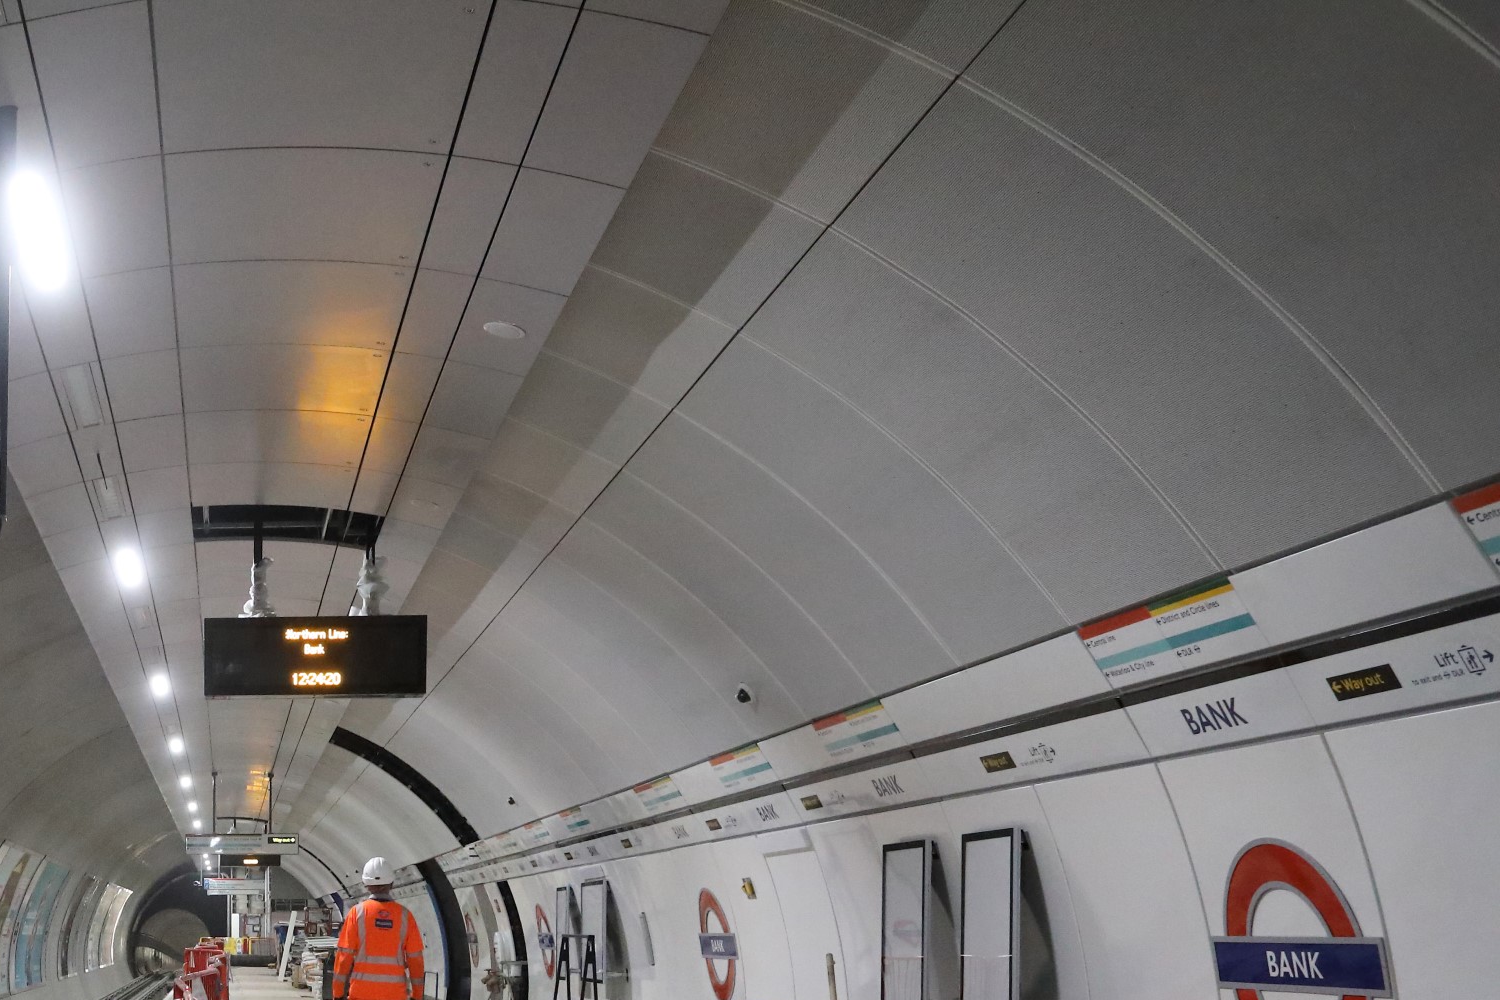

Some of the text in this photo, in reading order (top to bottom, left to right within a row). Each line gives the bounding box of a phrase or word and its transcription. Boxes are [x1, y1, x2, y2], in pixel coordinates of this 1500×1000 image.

[1179, 610, 1189, 621] and
[303, 644, 325, 655] Bank
[1182, 648, 1194, 657] DLR
[1434, 652, 1460, 668] Lift
[1342, 673, 1385, 693] Way out
[1180, 697, 1249, 735] BANK
[871, 774, 905, 797] BANK
[756, 804, 780, 822] BANK
[1266, 951, 1324, 979] BANK
